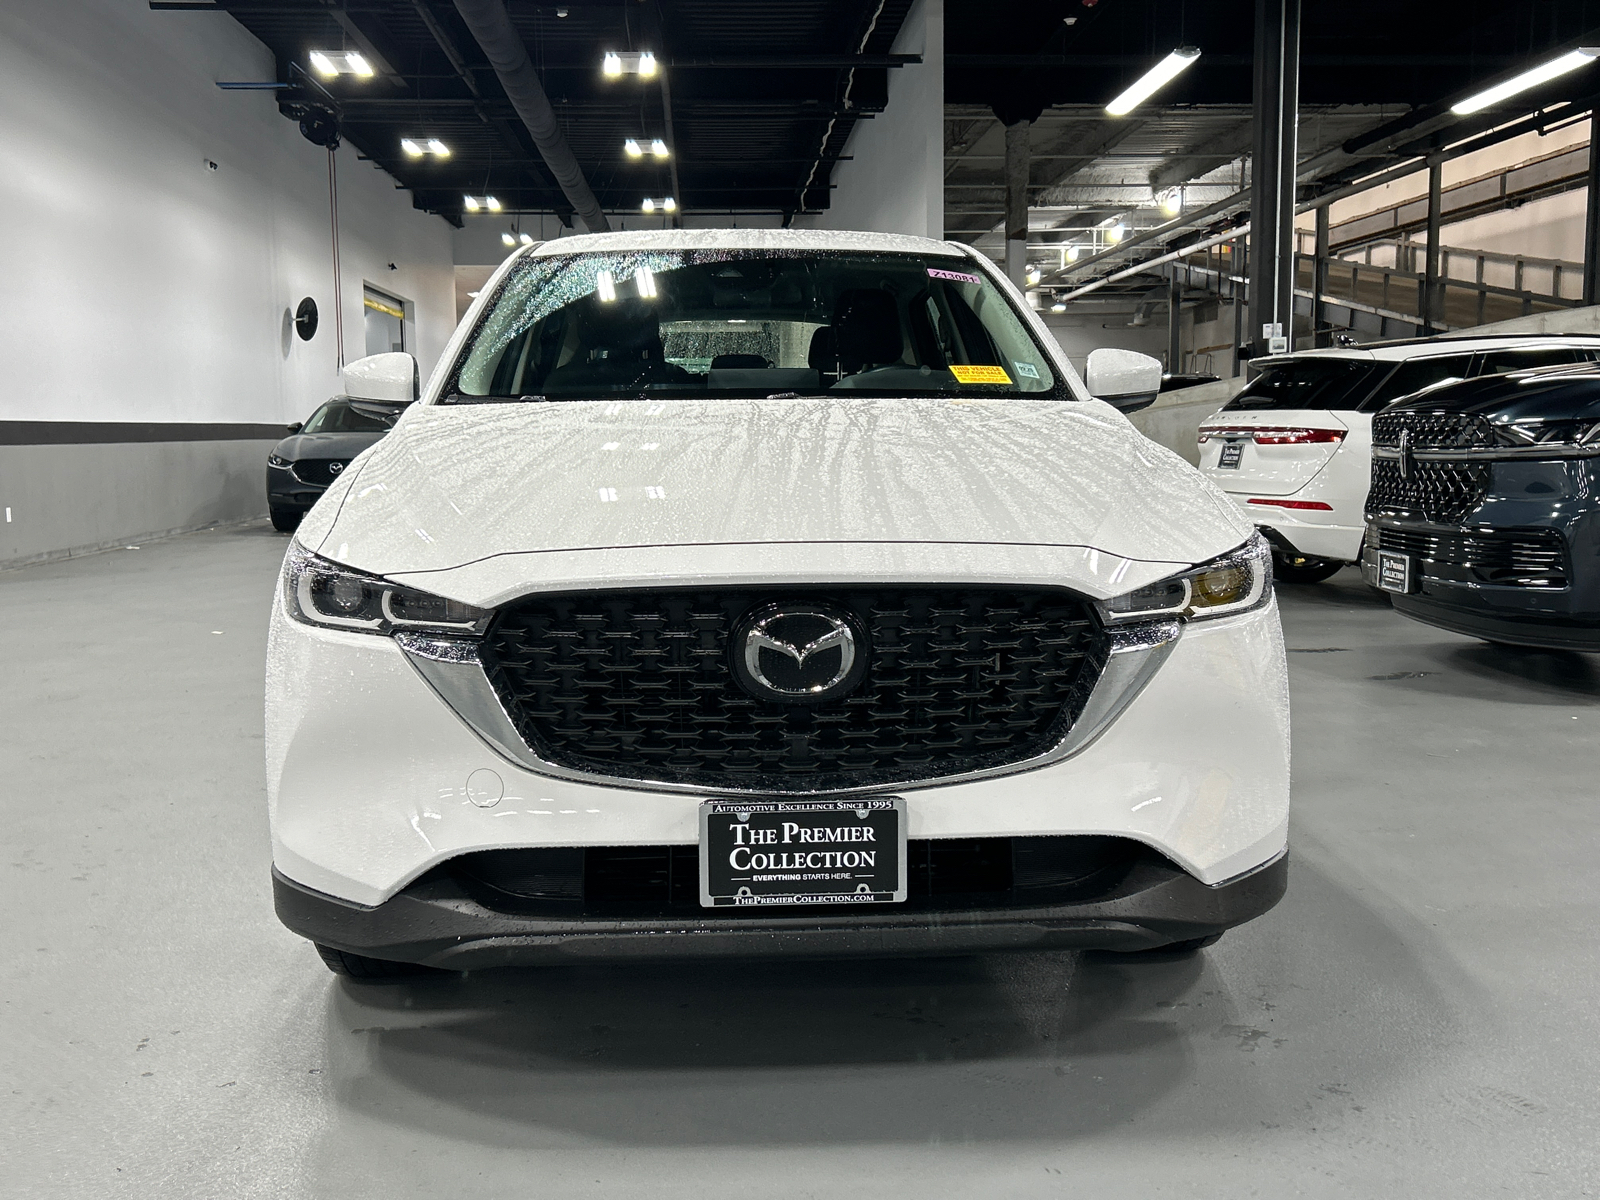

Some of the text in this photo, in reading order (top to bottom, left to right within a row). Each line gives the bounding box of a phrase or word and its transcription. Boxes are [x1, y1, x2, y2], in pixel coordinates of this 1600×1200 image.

[714, 801, 892, 813] AUTOMOTIVE EXCELLENCE SINCE 1995
[729, 822, 876, 846] THE PREMIER
[729, 847, 876, 870] COLLECTION
[752, 872, 853, 882] EVERYTHING STARTS HERE.
